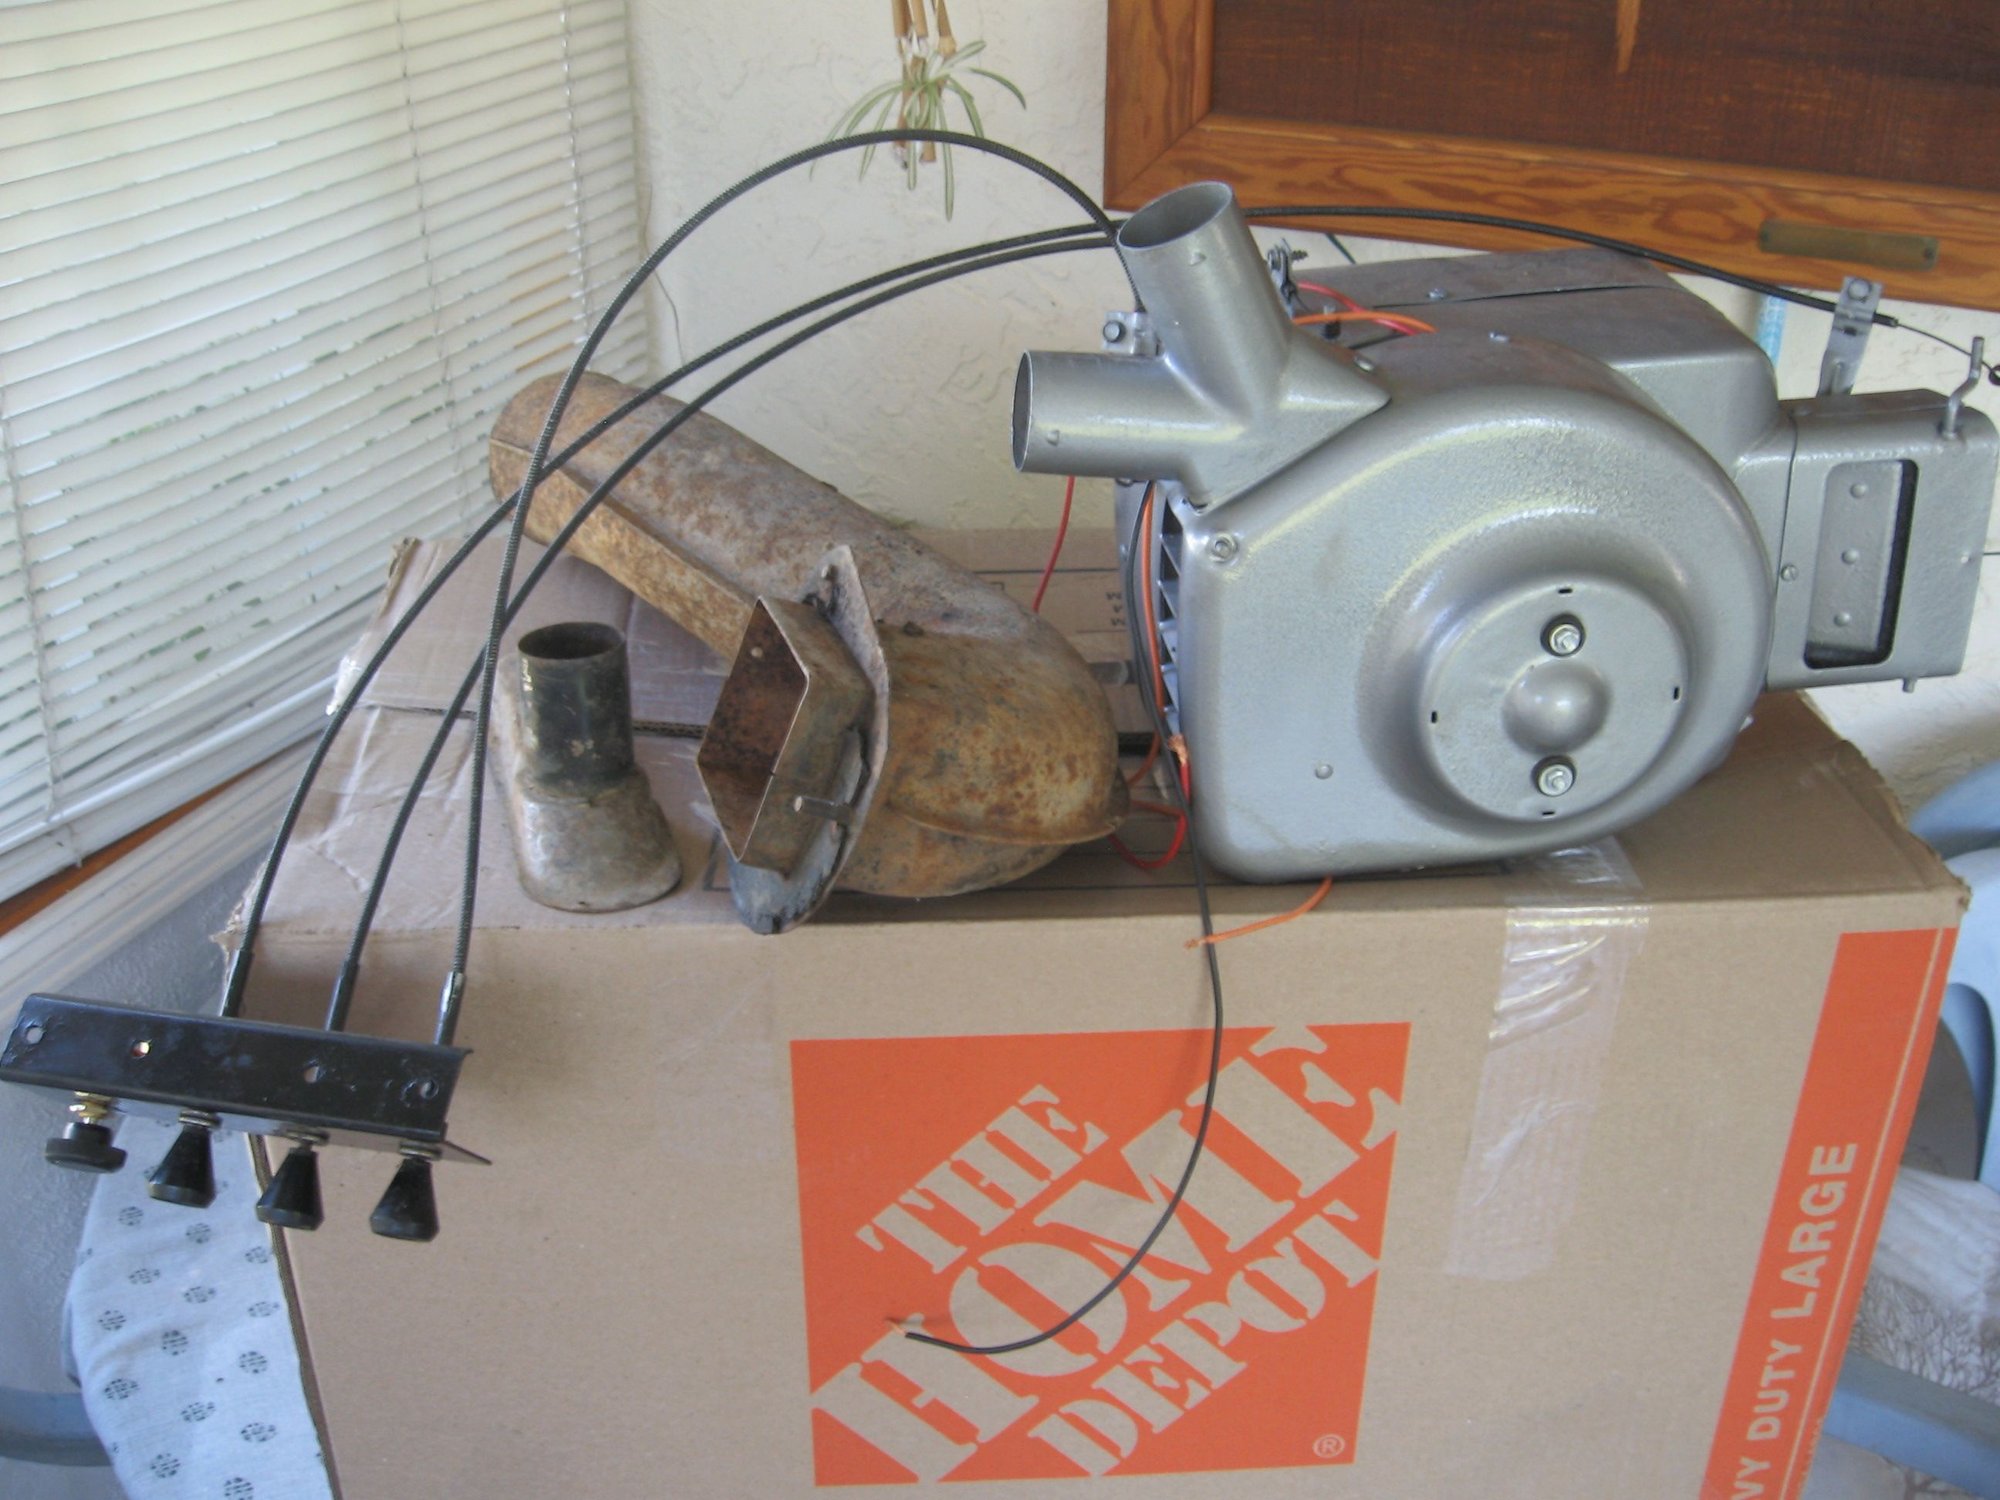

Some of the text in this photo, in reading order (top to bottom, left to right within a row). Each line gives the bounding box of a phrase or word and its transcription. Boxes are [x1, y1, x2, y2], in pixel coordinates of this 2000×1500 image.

[810, 1023, 1402, 1482] HOME
[855, 1084, 1109, 1274] THE
[1769, 1143, 1858, 1320] LARGE
[1027, 1199, 1380, 1477] DEPOT
[1746, 1339, 1803, 1441] DUTY
